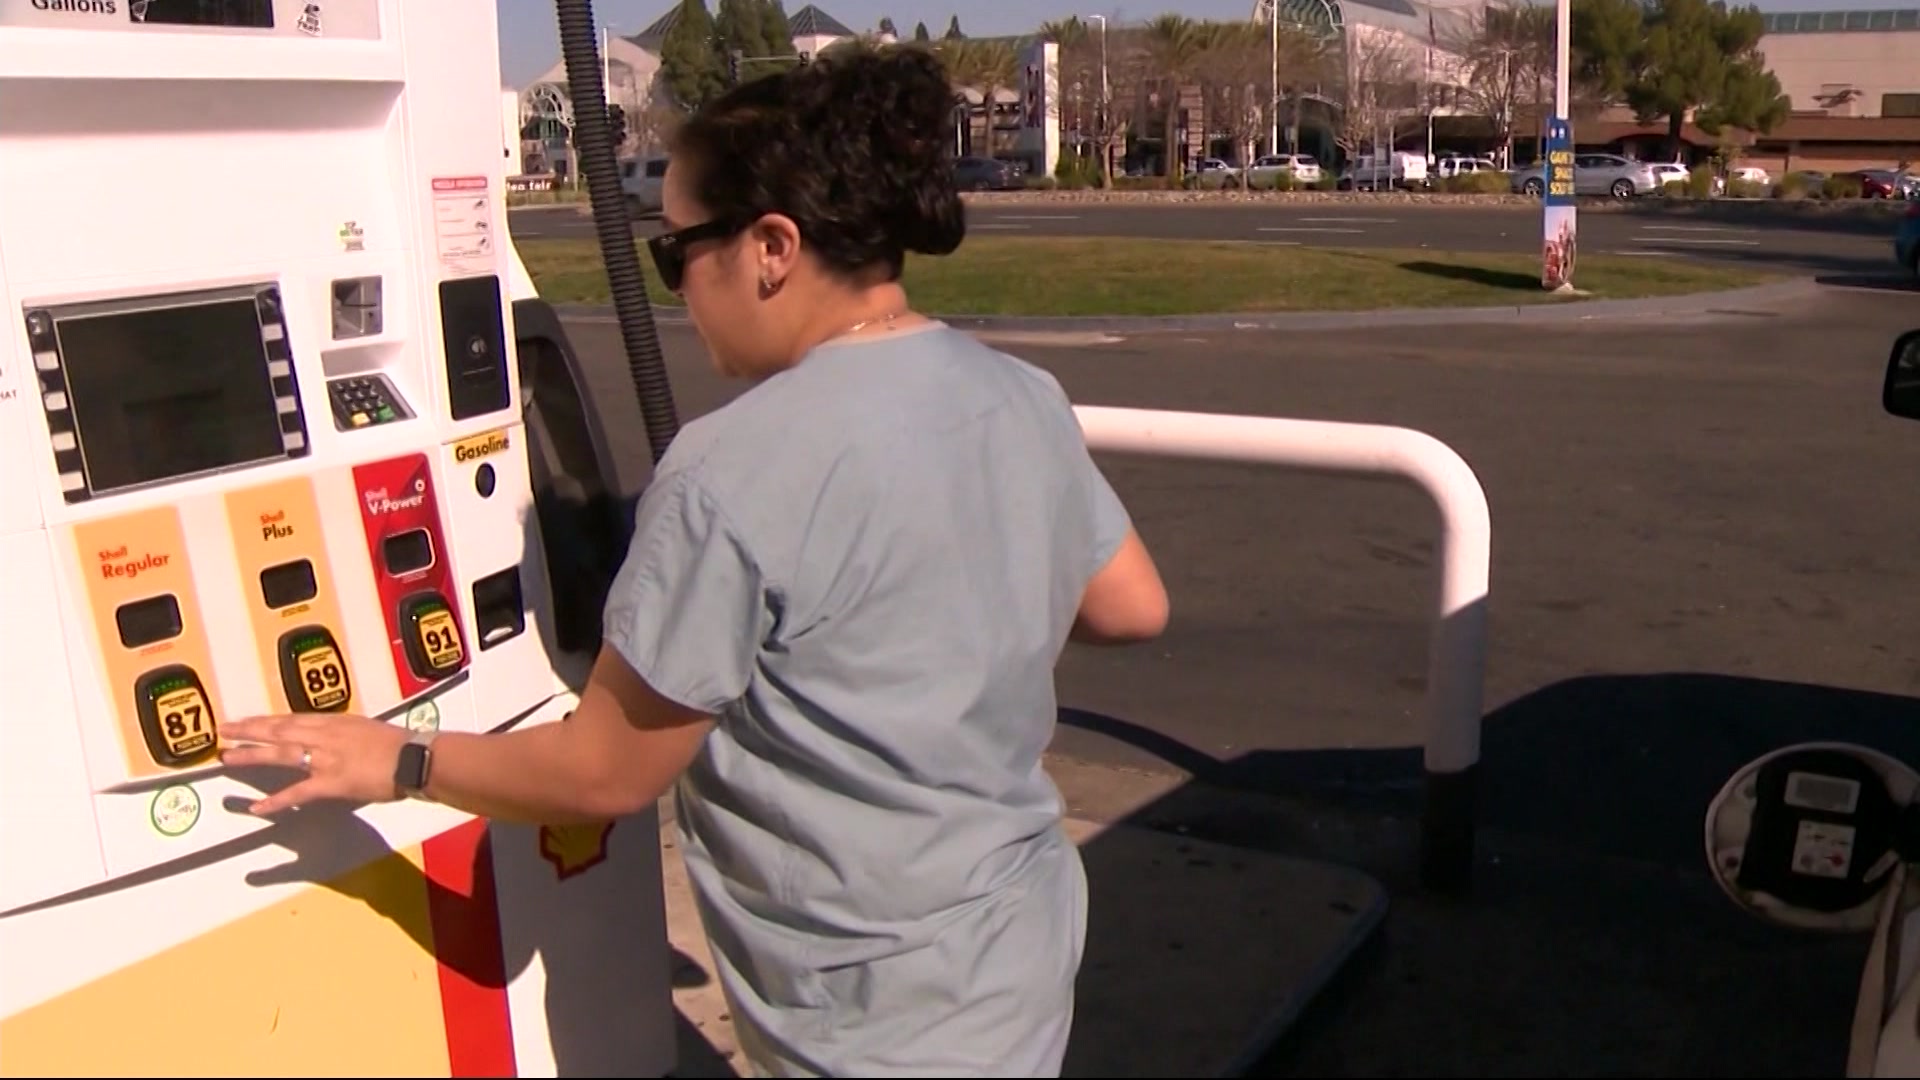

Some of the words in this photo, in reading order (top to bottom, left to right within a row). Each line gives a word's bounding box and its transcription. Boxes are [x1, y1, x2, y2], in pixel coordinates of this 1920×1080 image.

[455, 435, 510, 462] Gasoline
[367, 494, 425, 516] V-Power
[262, 523, 294, 541] Plus
[98, 545, 128, 562] Shell
[101, 553, 171, 580] Regular
[425, 626, 457, 654] 91
[306, 663, 340, 694] 89
[165, 704, 202, 739] 87
